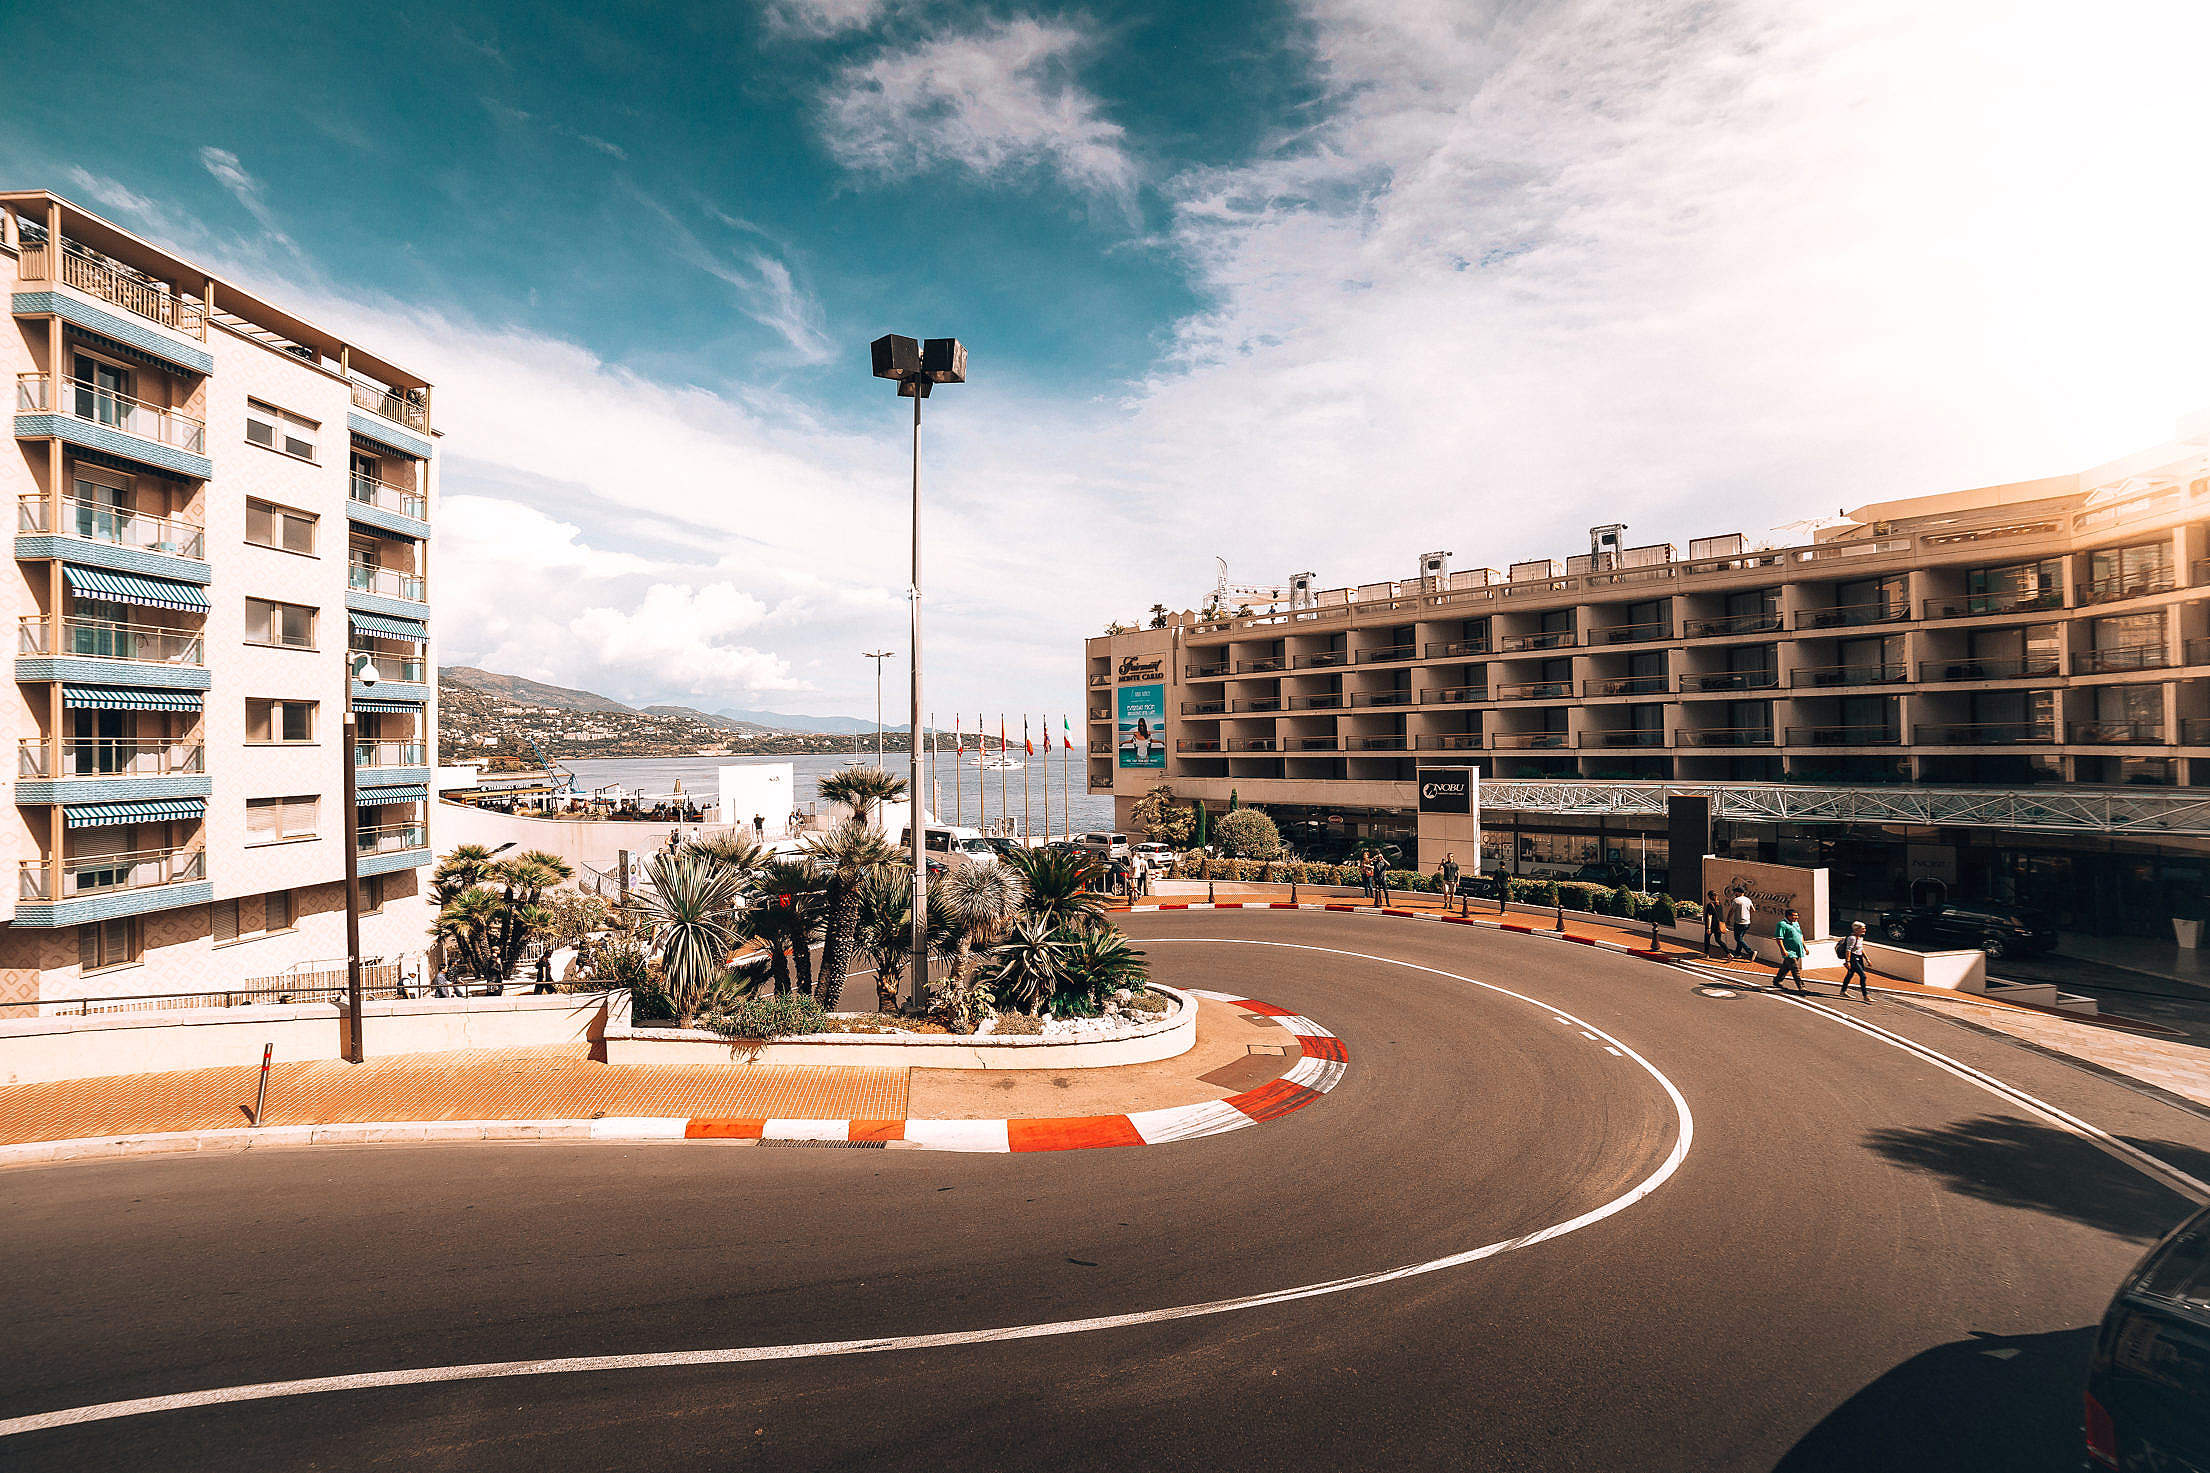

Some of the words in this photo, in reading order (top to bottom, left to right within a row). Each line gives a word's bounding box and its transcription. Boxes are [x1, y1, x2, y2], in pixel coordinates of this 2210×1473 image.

[1118, 656, 1163, 675] Fairmont
[1141, 672, 1164, 680] CARLO
[1433, 783, 1465, 791] NOBU
